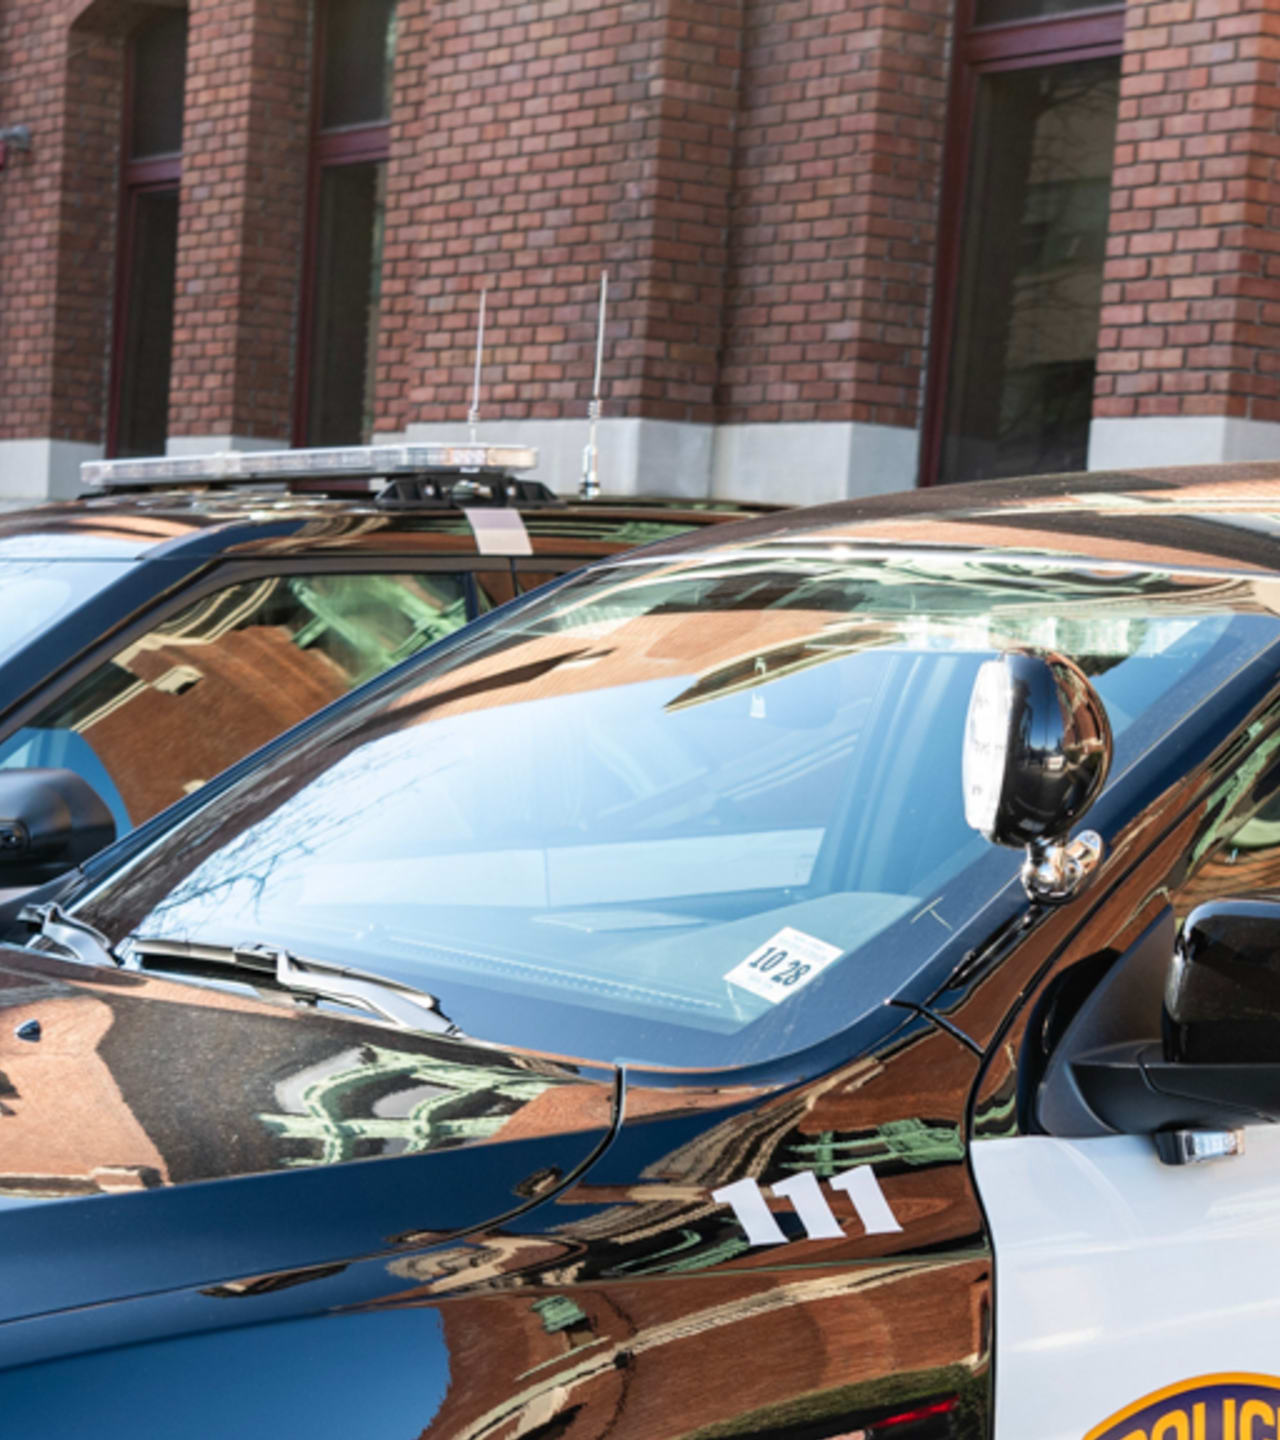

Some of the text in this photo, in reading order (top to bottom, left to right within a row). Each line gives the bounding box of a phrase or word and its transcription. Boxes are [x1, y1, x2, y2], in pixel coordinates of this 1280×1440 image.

[749, 947, 788, 972] 10
[771, 960, 811, 986] 28
[711, 1165, 904, 1247] 111
